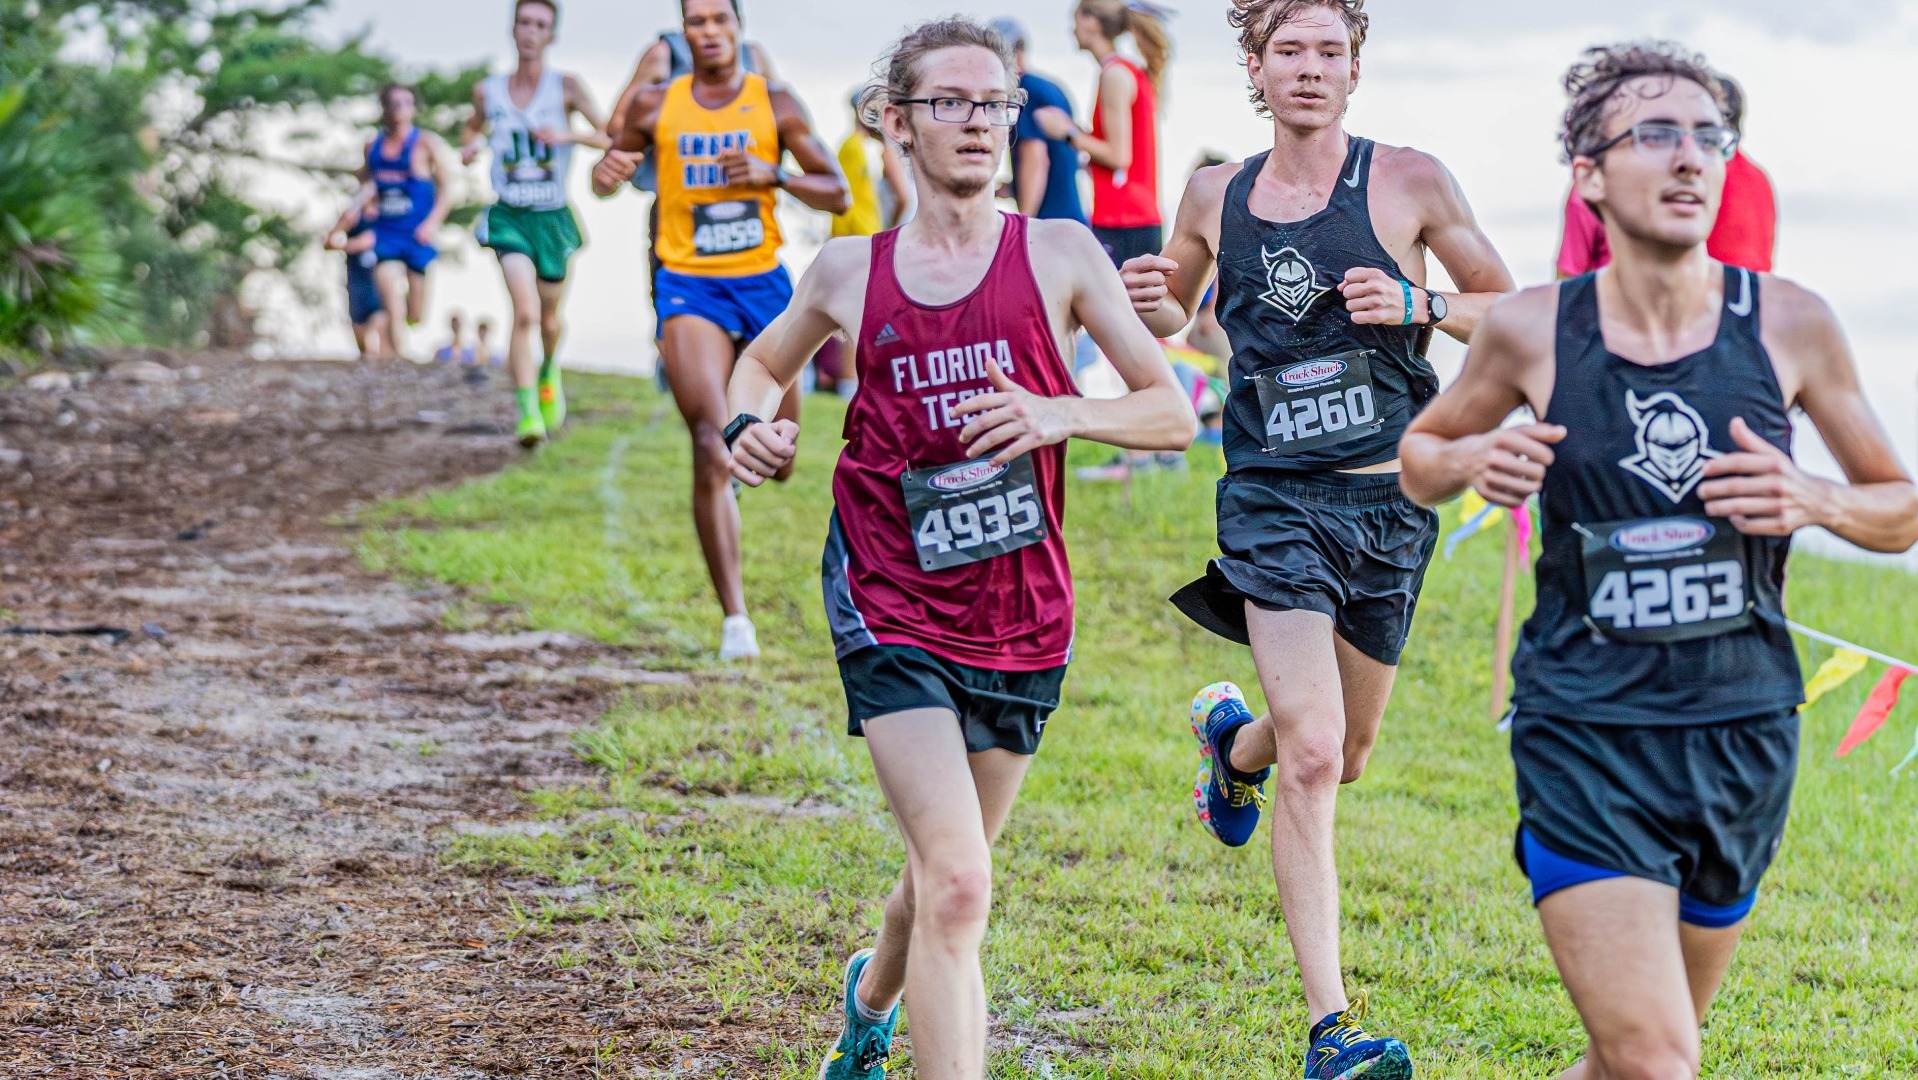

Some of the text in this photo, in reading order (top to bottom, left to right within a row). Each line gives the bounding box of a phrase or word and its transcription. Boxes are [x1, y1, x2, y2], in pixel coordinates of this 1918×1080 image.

[694, 217, 763, 253] 4859
[891, 340, 1015, 393] FLORIDA
[1284, 361, 1343, 382] Track Shack
[1266, 385, 1375, 442] 4260
[935, 471, 968, 487] Track
[918, 484, 1041, 553] 4935
[1590, 560, 1744, 628] 4263
